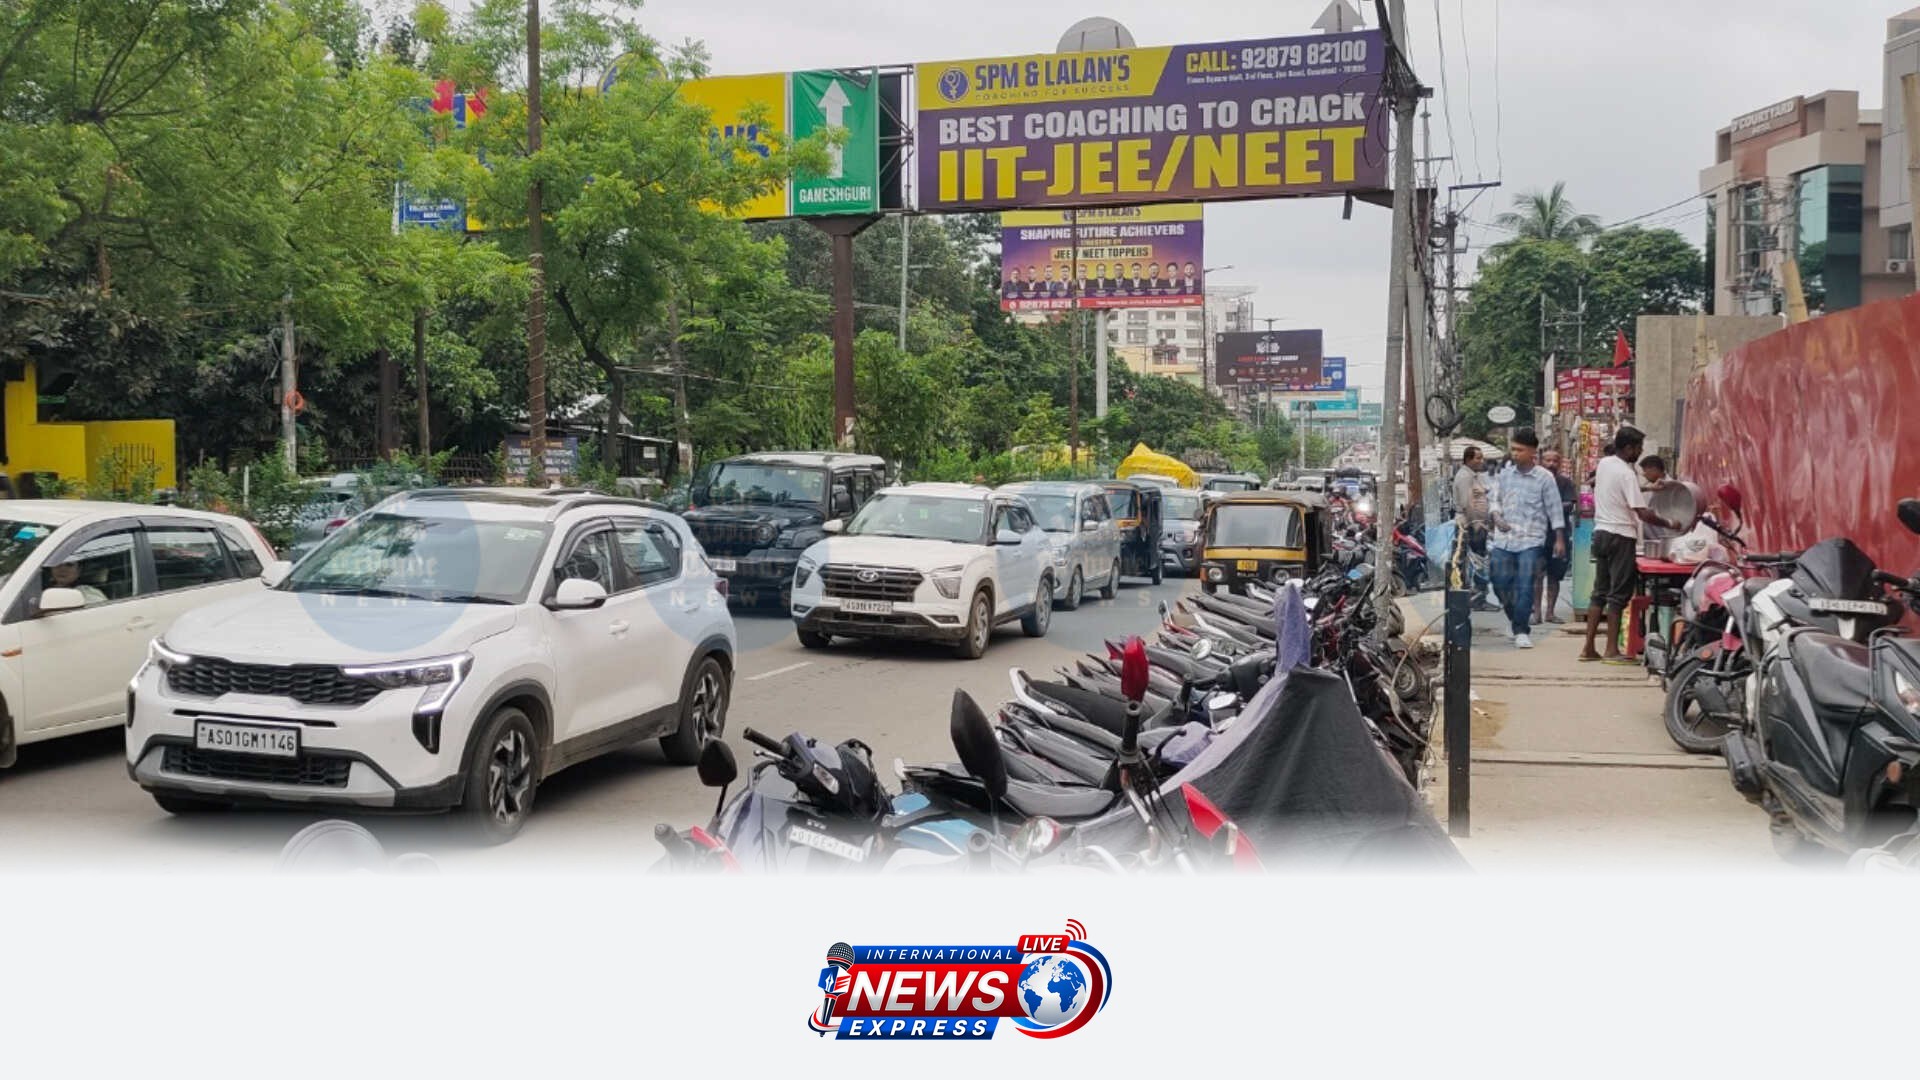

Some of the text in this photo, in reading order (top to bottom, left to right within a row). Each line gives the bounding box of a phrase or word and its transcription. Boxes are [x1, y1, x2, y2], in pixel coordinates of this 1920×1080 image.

[975, 54, 1131, 91] SPM & LALAN'S
[1186, 39, 1368, 73] CALL: 92879 82100
[938, 91, 1366, 146] BEST COACHING TO CRACK
[938, 125, 1367, 203] IIT-JEE/NEET
[799, 185, 872, 204] GANESHGURI
[1020, 223, 1185, 241] SHAPING FUTURE ACHIEVERS
[207, 727, 295, 751] AS01GM1146
